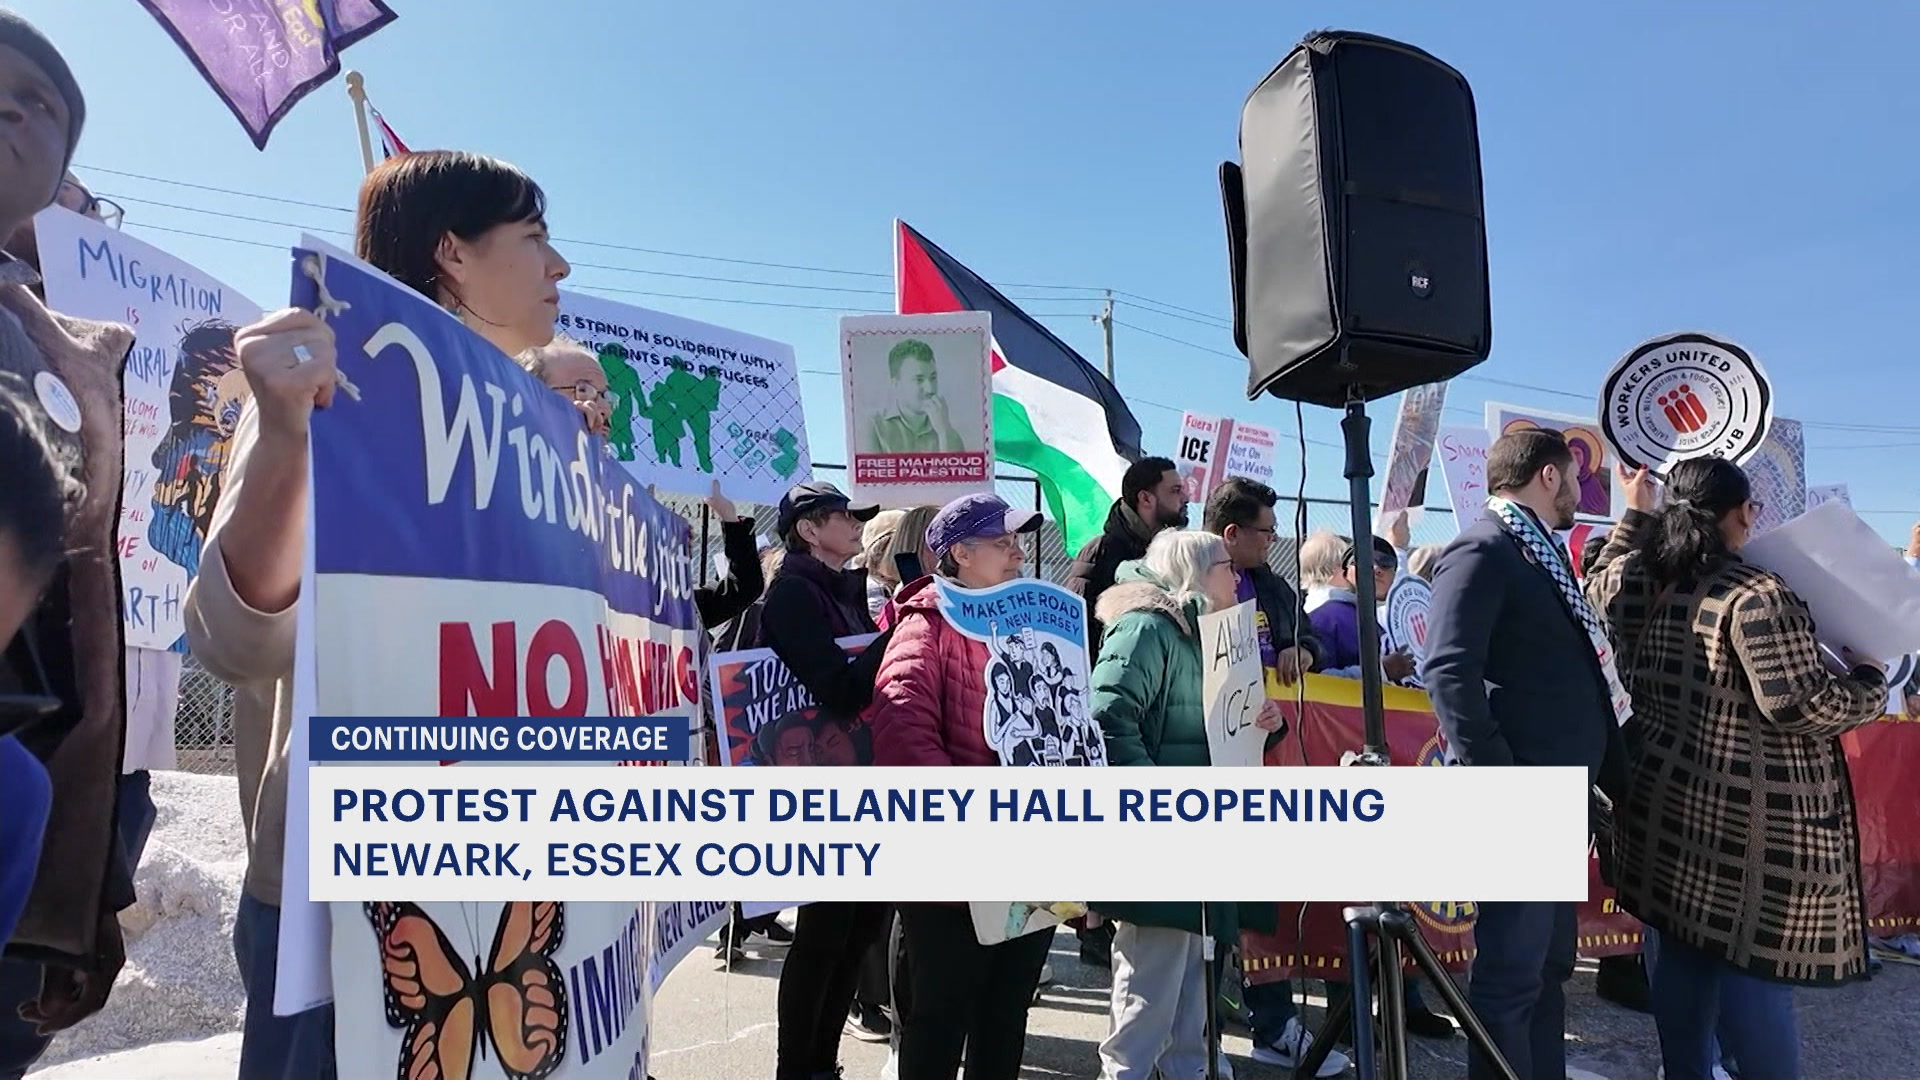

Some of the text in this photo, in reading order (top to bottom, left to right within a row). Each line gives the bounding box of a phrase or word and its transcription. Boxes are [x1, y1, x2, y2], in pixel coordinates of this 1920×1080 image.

[78, 237, 222, 316] MIGRATION
[1412, 276, 1429, 289] RCF
[126, 307, 140, 325] IS
[575, 316, 629, 338] STAND
[634, 328, 649, 343] IN
[653, 334, 737, 362] SOLIDARITY
[741, 354, 776, 371] WITH
[664, 356, 695, 373] AND
[699, 364, 769, 389] REFUGEES
[1617, 350, 1732, 428] WORKERS UNITED
[363, 322, 599, 541] Wind
[606, 482, 648, 578] the
[858, 457, 983, 468] FREE MAHMOUD
[1180, 436, 1211, 463] ICE
[858, 467, 983, 478] FREE PALESTINE
[124, 584, 179, 634] RTH
[962, 591, 1080, 620] MAKE THE ROAD
[1005, 611, 1080, 636] NEW JERSEY
[438, 619, 588, 735] NO
[746, 692, 782, 734] WE
[1222, 680, 1258, 743] ICE
